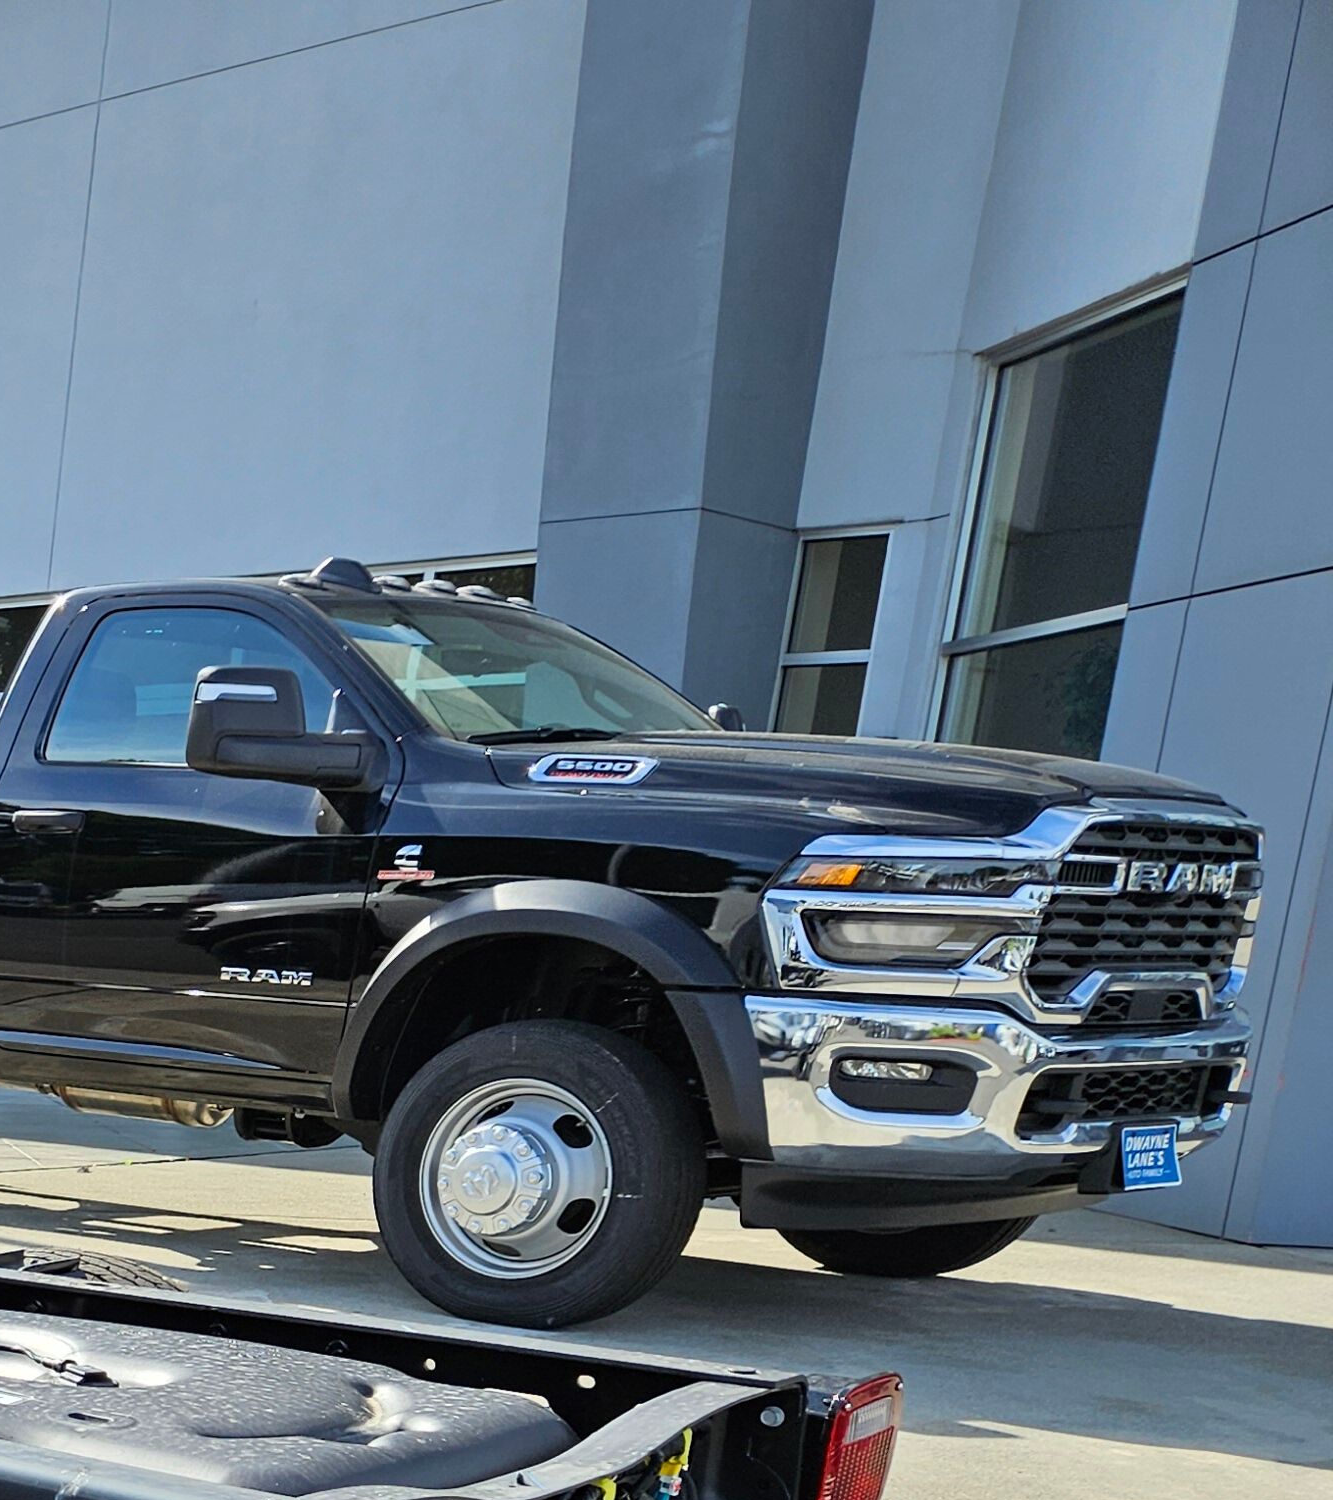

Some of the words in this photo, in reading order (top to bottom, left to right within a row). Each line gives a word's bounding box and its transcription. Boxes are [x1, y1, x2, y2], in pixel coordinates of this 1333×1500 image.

[557, 760, 633, 771] 5500
[1128, 861, 1237, 894] RAM
[219, 966, 313, 986] RAM
[1125, 1133, 1171, 1152] DWAYNE
[1127, 1150, 1165, 1169] LANE'S
